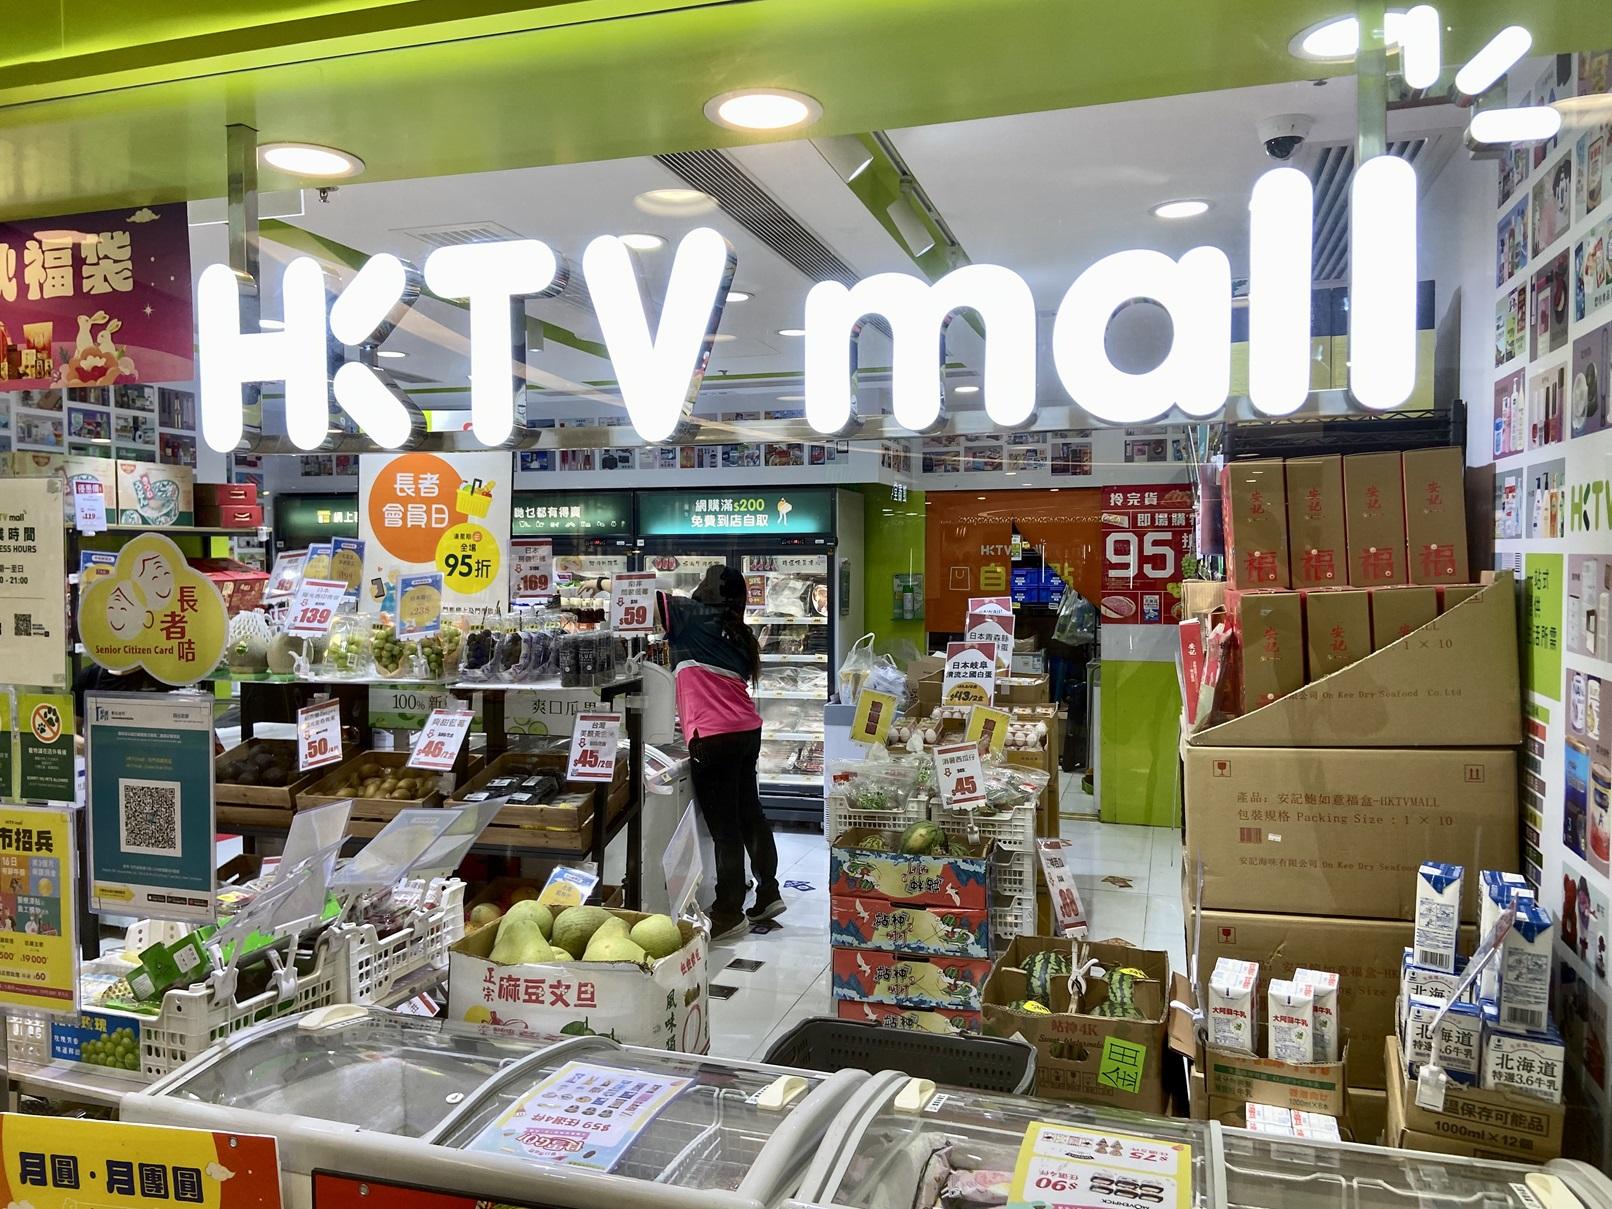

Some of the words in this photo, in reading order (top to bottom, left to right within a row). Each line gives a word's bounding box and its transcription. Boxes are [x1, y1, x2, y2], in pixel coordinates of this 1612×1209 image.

[198, 228, 726, 452] HKTV
[802, 156, 1417, 433] mall
[393, 473, 440, 497] 長者
[695, 498, 765, 512] 網購滿$200
[1109, 492, 1158, 506] 拎完貨
[382, 504, 449, 529] 會員日
[691, 514, 768, 527] 免費到店自取
[1137, 513, 1195, 527] 即場購
[13, 545, 37, 553] HOURS
[460, 543, 477, 552] 全場
[1244, 551, 1278, 583] 福
[1300, 549, 1335, 582] 福
[1360, 546, 1394, 579] 福
[1419, 544, 1457, 577] 福
[516, 574, 549, 591] $169
[160, 586, 198, 662] 長者咭
[293, 607, 332, 624] $139
[619, 606, 648, 626] $59
[96, 645, 121, 655] Senior
[123, 645, 152, 655] Citizen
[154, 645, 174, 655] Card
[1439, 639, 1453, 648] 10
[952, 661, 988, 669] 日本岐阜
[392, 694, 425, 710] 100%
[428, 695, 448, 710] 新
[1358, 691, 1375, 699] Dry
[1379, 690, 1419, 698] Seafood
[952, 776, 977, 796] $45
[1237, 809, 1290, 821] 包裝規格
[1297, 812, 1347, 824] Packing
[1354, 813, 1383, 824] Size
[1404, 816, 1409, 825] 1
[1440, 816, 1453, 825] 10
[482, 967, 496, 1002] 正宗
[498, 974, 597, 1008] 麻豆文旦
[1413, 1039, 1475, 1060] 特選.6牛乳
[1495, 1053, 1558, 1078] 北海道
[1491, 1070, 1559, 1091] 特選3.6牛乳
[1446, 1101, 1545, 1133] 温保存可能品
[582, 1121, 611, 1132] $59
[1434, 1120, 1485, 1140] 1000ml
[1502, 1134, 1533, 1150] 12個
[1129, 1151, 1168, 1162] $75
[1035, 1177, 1079, 1192] $90
